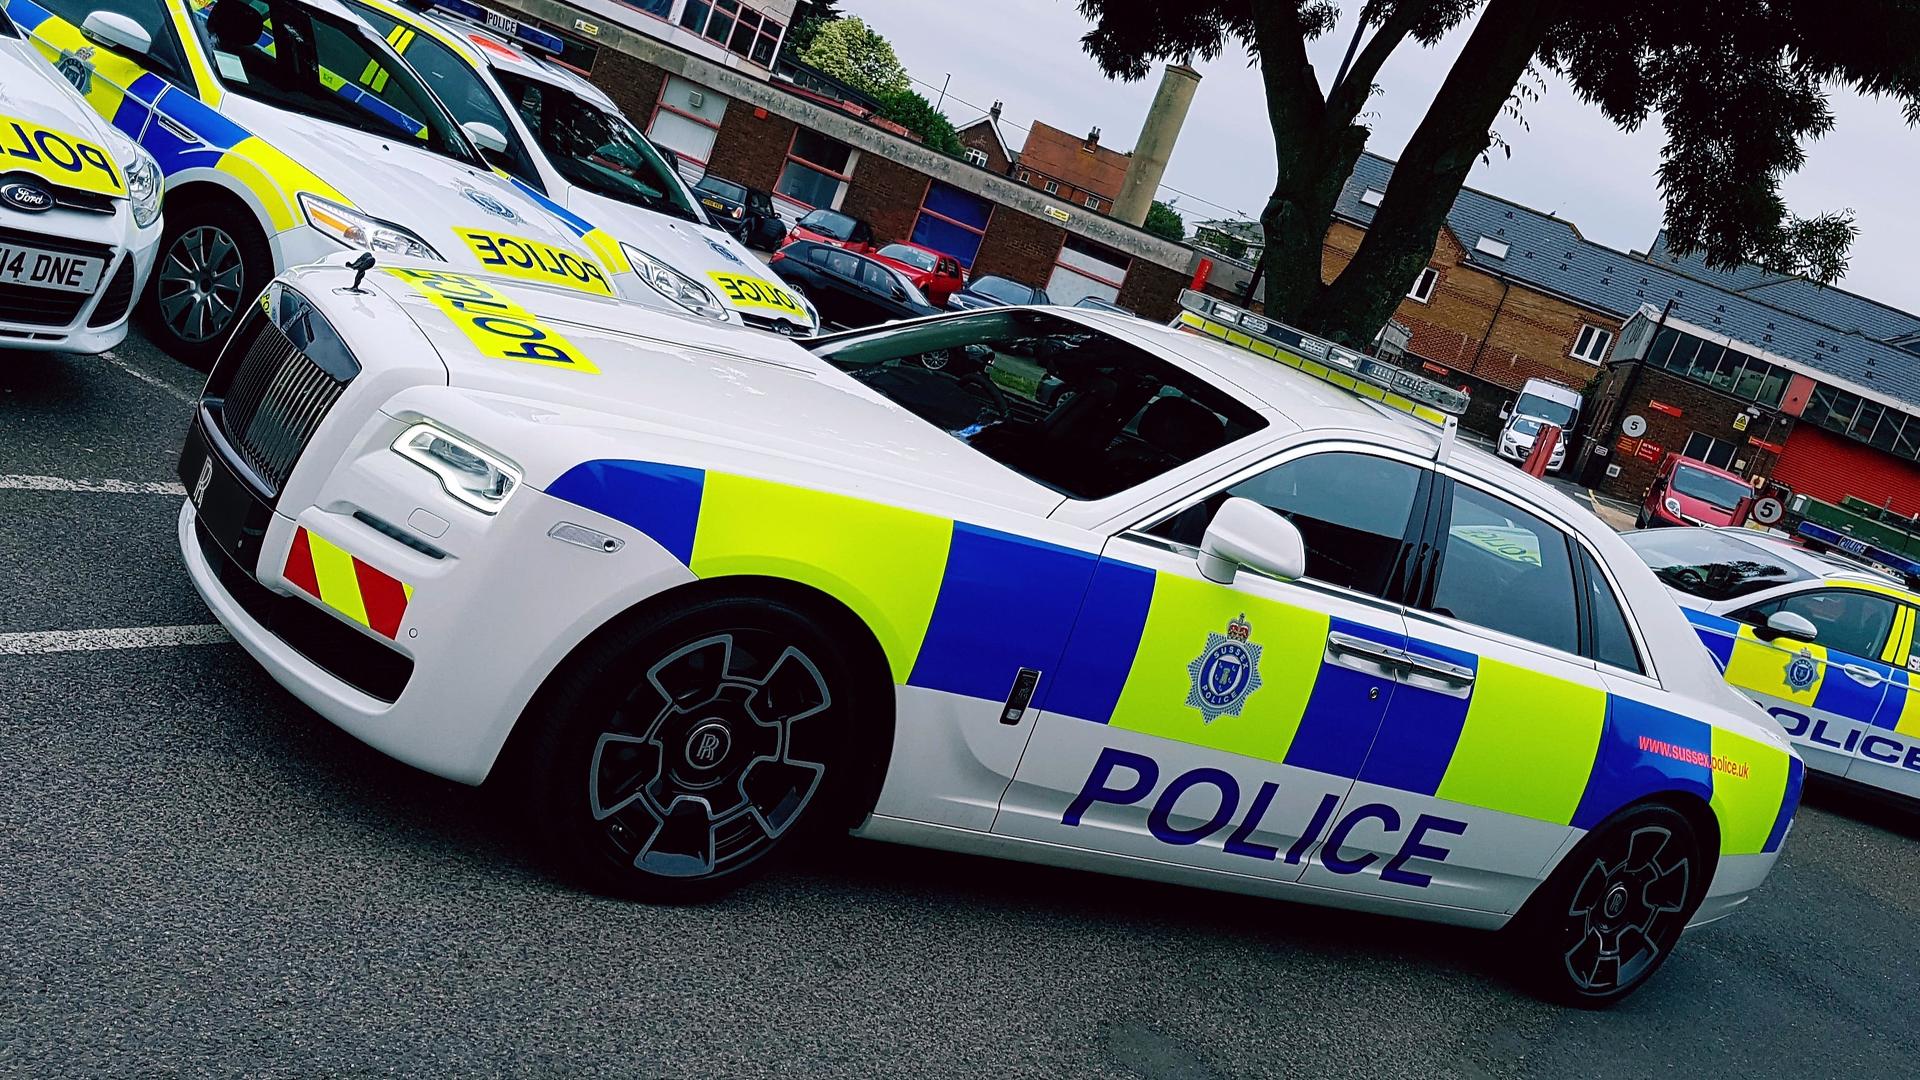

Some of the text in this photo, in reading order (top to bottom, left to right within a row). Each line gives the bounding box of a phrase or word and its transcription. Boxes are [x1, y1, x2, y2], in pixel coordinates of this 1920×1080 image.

[487, 11, 518, 34] POLICE
[15, 187, 43, 204] Ford
[0, 247, 87, 287] 14 DNE
[1630, 421, 1640, 431] 5
[1760, 502, 1776, 518] 5
[1840, 538, 1866, 554] POLICE
[1213, 646, 1248, 669] SUSSEX
[1202, 684, 1237, 704] POLICE
[1753, 700, 1920, 772] OLICE
[1638, 735, 1750, 779] www.sussex.police.uk
[1060, 746, 1469, 888] POLICE
